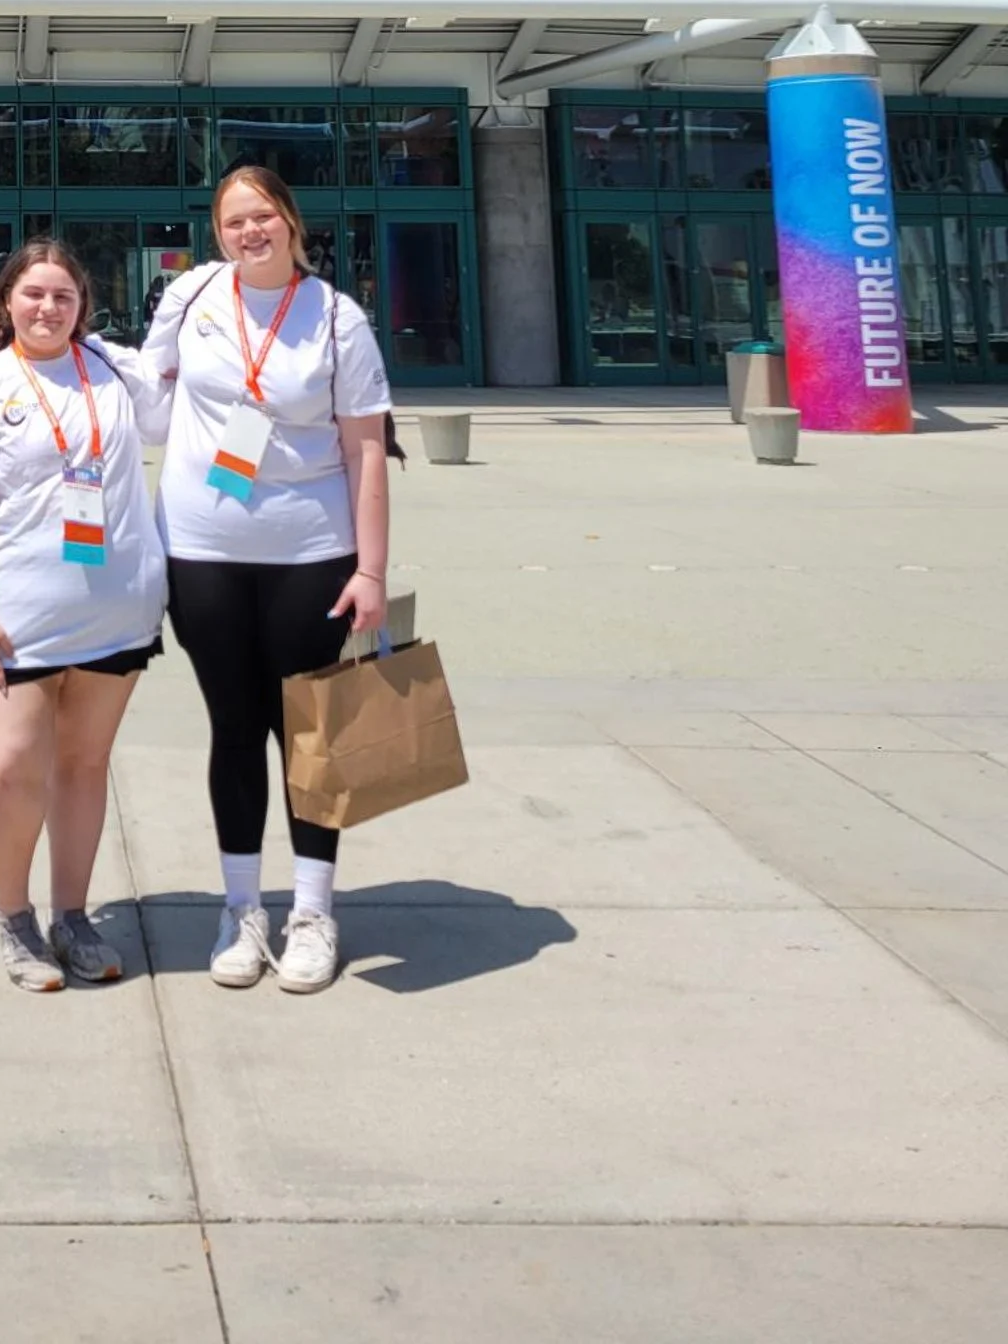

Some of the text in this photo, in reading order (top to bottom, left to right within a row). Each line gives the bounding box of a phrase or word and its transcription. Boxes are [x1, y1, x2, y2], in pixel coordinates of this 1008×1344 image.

[843, 118, 903, 388] FUTURE OF NOW
